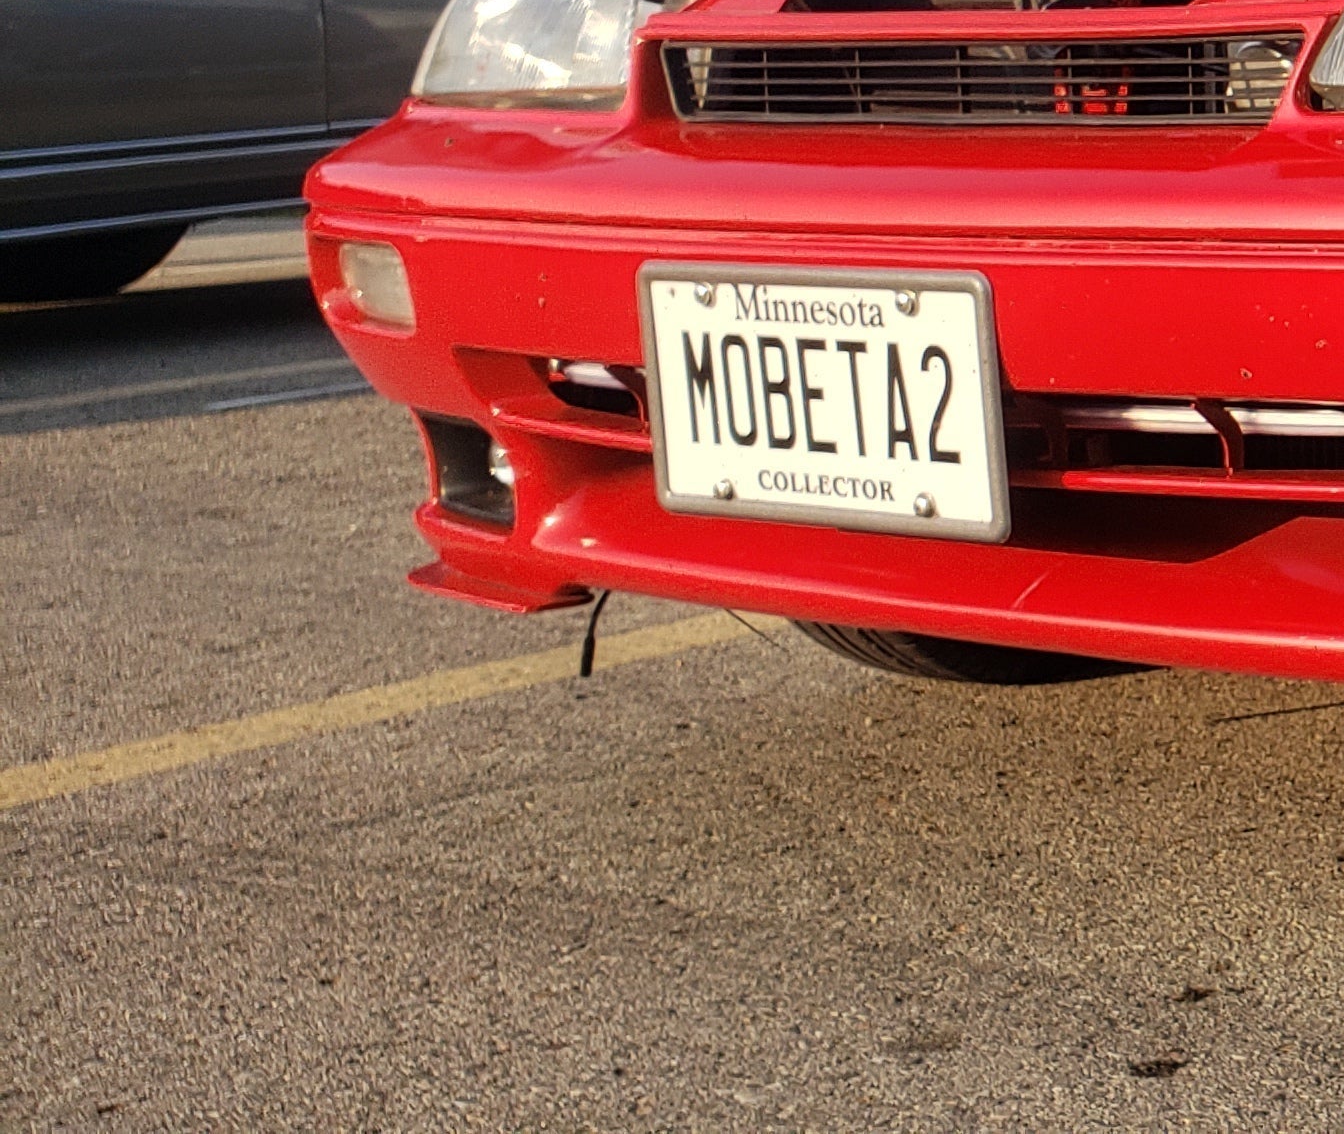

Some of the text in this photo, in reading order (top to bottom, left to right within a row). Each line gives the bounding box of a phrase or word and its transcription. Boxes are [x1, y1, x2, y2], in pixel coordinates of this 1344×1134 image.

[732, 284, 885, 327] Minnesota
[682, 330, 961, 464] MOBETA2
[757, 469, 896, 502] COLLECTOR
